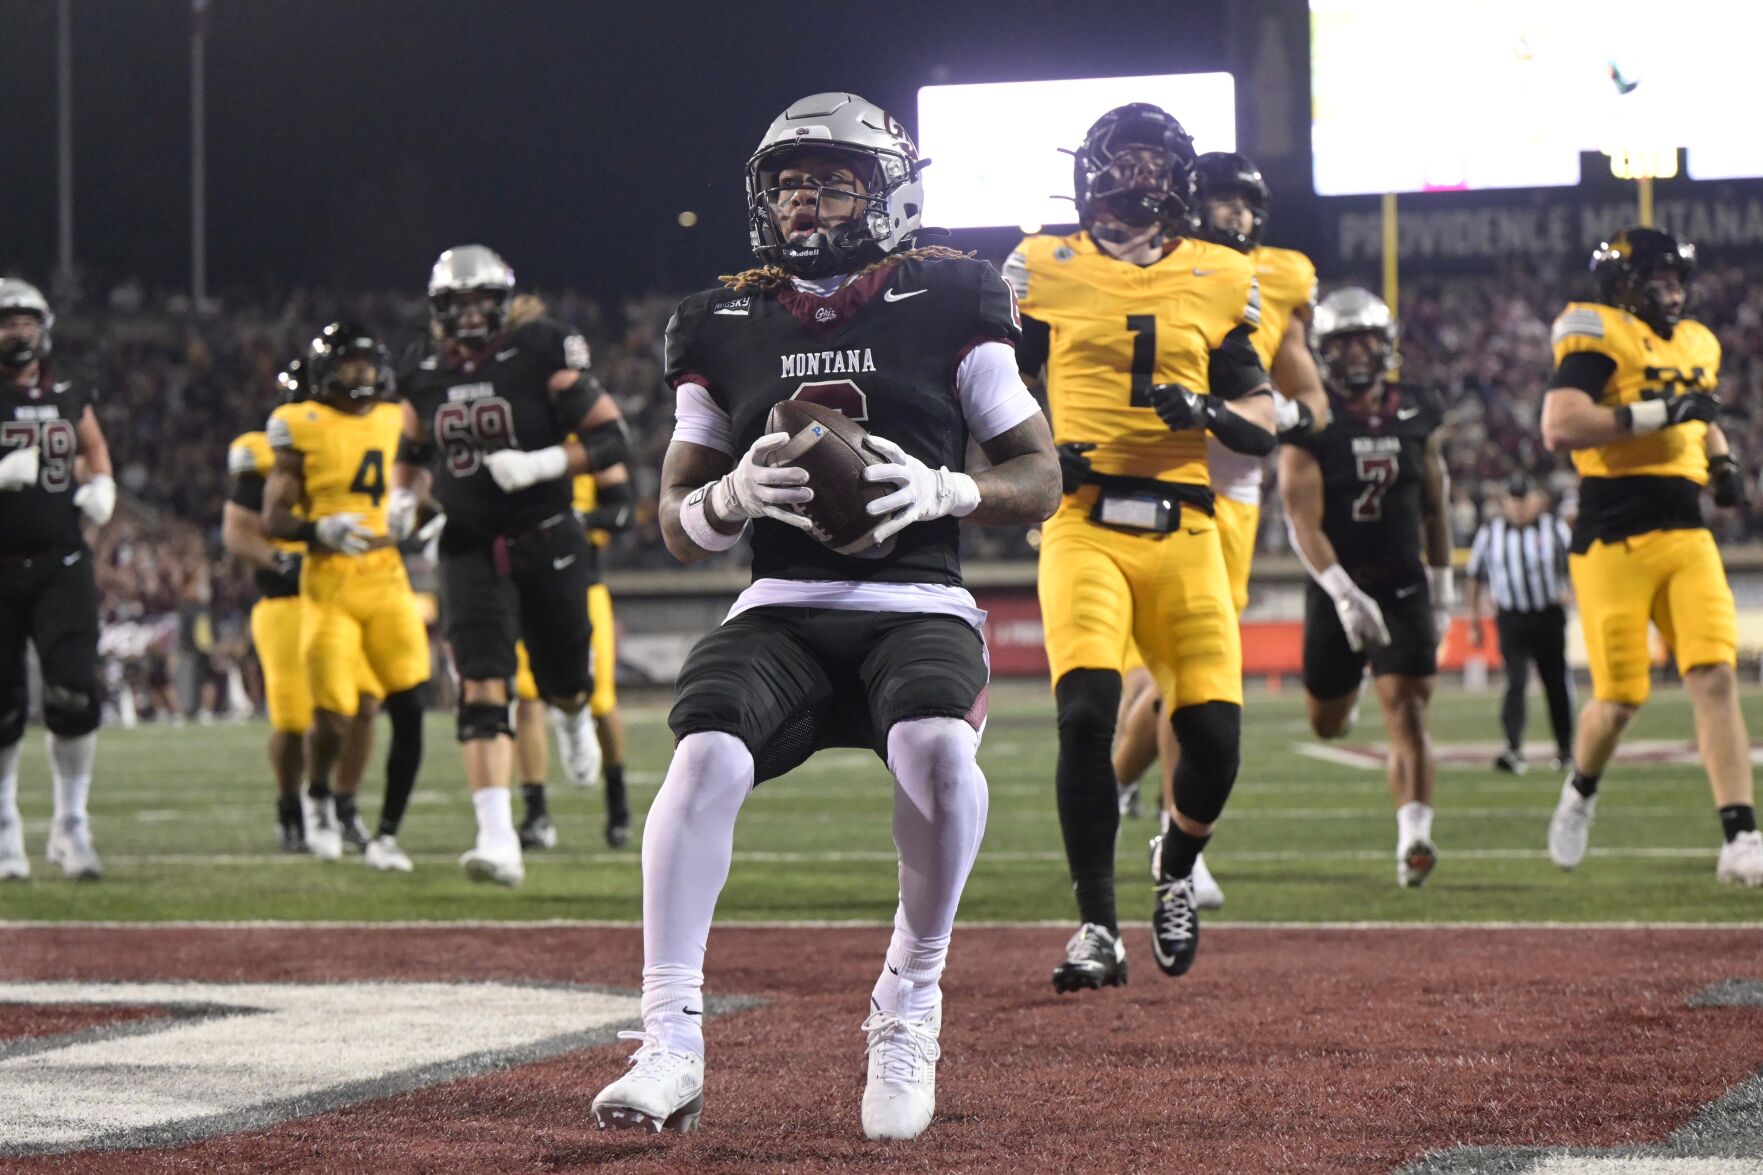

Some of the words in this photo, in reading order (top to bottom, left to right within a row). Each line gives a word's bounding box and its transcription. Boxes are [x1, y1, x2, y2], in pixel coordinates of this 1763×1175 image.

[1581, 201, 1763, 247] MOTANA
[780, 348, 876, 378] MONTANA
[1126, 315, 1155, 407] 1
[434, 396, 519, 477] 69
[350, 450, 386, 507] 4
[1352, 455, 1399, 522] 7
